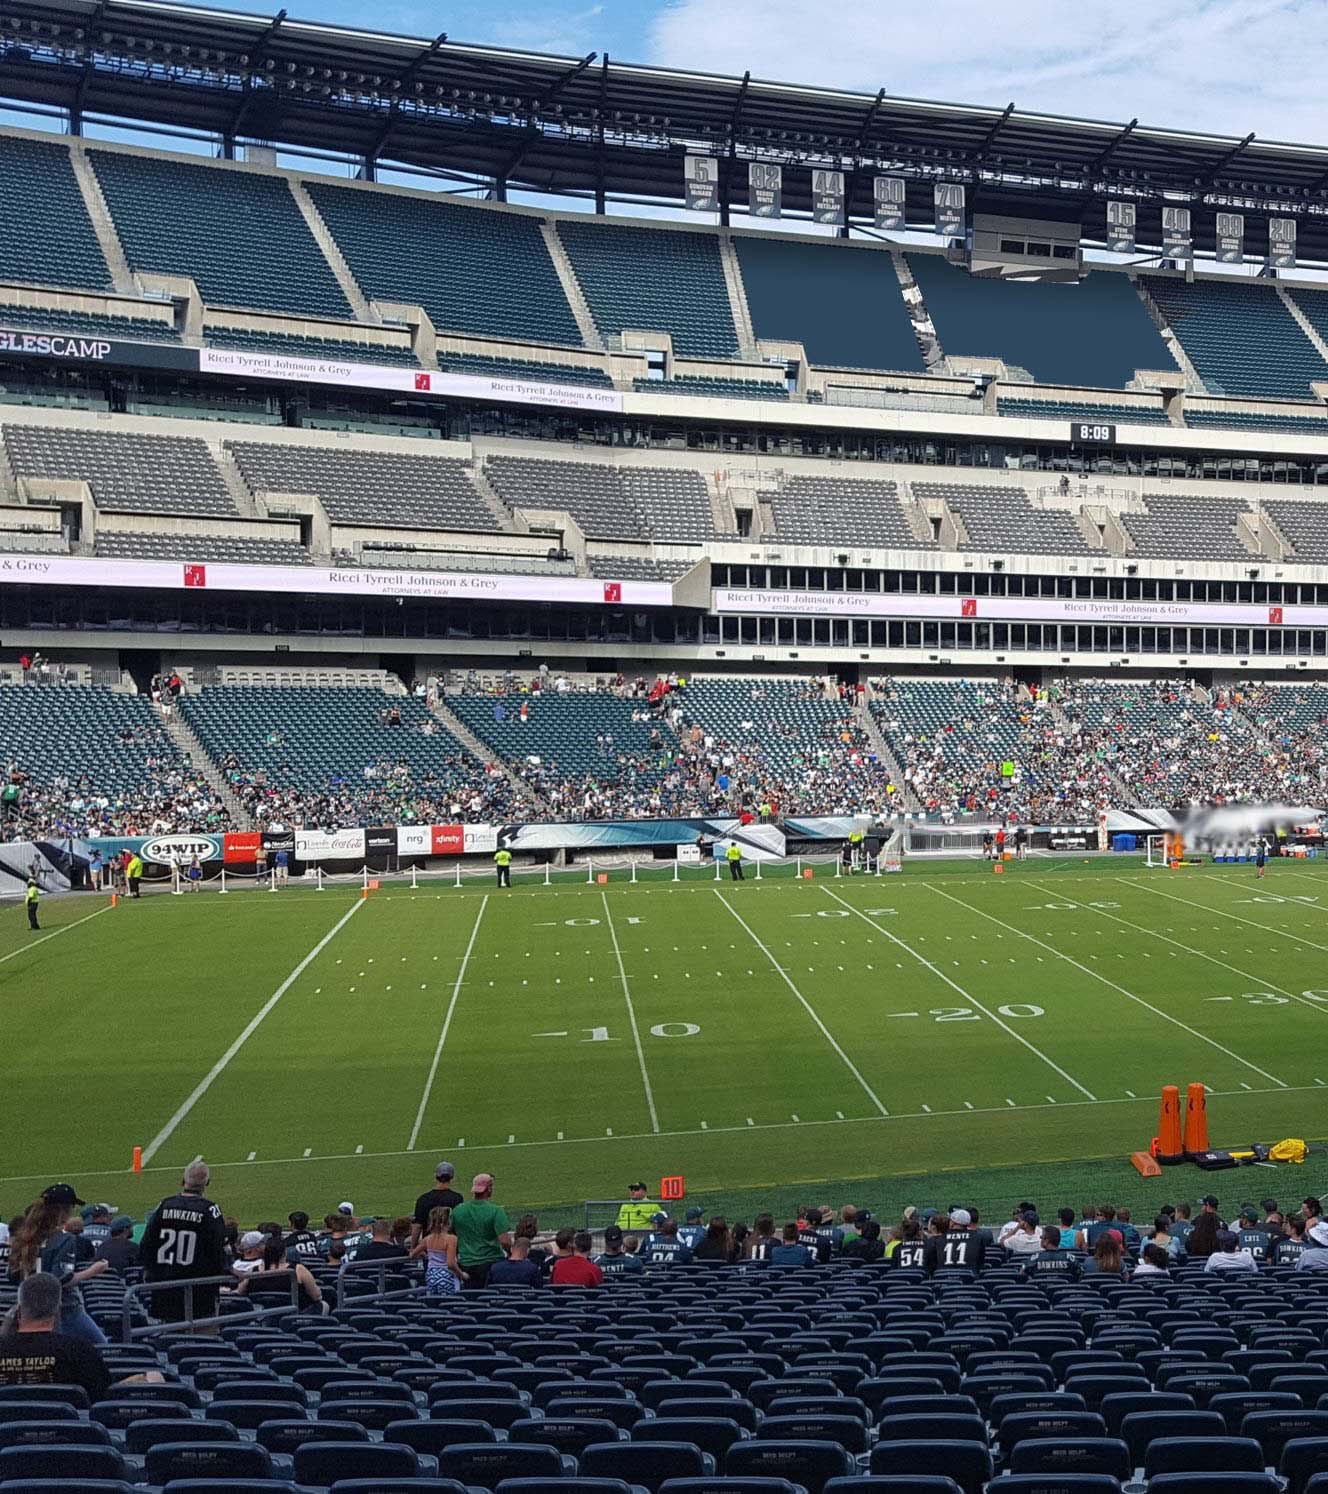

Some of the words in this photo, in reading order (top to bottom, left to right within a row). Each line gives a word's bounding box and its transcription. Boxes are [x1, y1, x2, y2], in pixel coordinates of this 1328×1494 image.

[694, 158, 709, 183] 5
[751, 164, 780, 190] 92
[815, 171, 842, 197] 44
[875, 179, 904, 203] 60
[934, 185, 962, 209] 70
[1109, 203, 1134, 226] 15
[1164, 209, 1189, 232] 40
[1216, 214, 1242, 238] 99
[1270, 219, 1295, 242] 20
[208, 353, 234, 363] Ricci
[237, 356, 270, 367] Tyrrell
[274, 359, 316, 372] Johnson
[328, 366, 352, 376] Grey
[491, 382, 514, 391] Ricci
[516, 383, 545, 395] Tyrrell
[548, 388, 585, 399] Johnson
[594, 393, 615, 403] Grey
[1080, 425, 1109, 440] 8:09
[2, 559, 13, 570] &
[16, 559, 50, 573] Grey
[329, 572, 360, 583] Ricci
[363, 573, 403, 585] Tyrrell
[407, 576, 456, 586] Johnson
[471, 579, 498, 590] Grey
[727, 593, 754, 602] Ricci
[757, 594, 789, 605] Tyrrell
[792, 595, 834, 604] Johnson
[846, 597, 870, 606] Grey
[1064, 604, 1087, 612] Ricci
[1089, 604, 1119, 615] Tyrrell
[1121, 605, 1158, 614] Johnson
[1168, 606, 1189, 615] Grey
[406, 835, 423, 845] nrg
[435, 834, 460, 844] xfinity
[151, 843, 209, 855] 94WIP
[928, 1004, 1045, 1022] 20
[580, 1022, 701, 1042] 10
[663, 1178, 682, 1199] 10
[163, 1208, 203, 1223] DAWKINS
[157, 1228, 197, 1266] 20
[651, 1243, 681, 1251] MATTHEWS
[751, 1244, 766, 1260] 11
[943, 1242, 967, 1265] 11
[900, 1248, 924, 1267] 54
[1037, 1261, 1068, 1269] DAWKINS
[25, 1356, 56, 1366] TAYLOR
